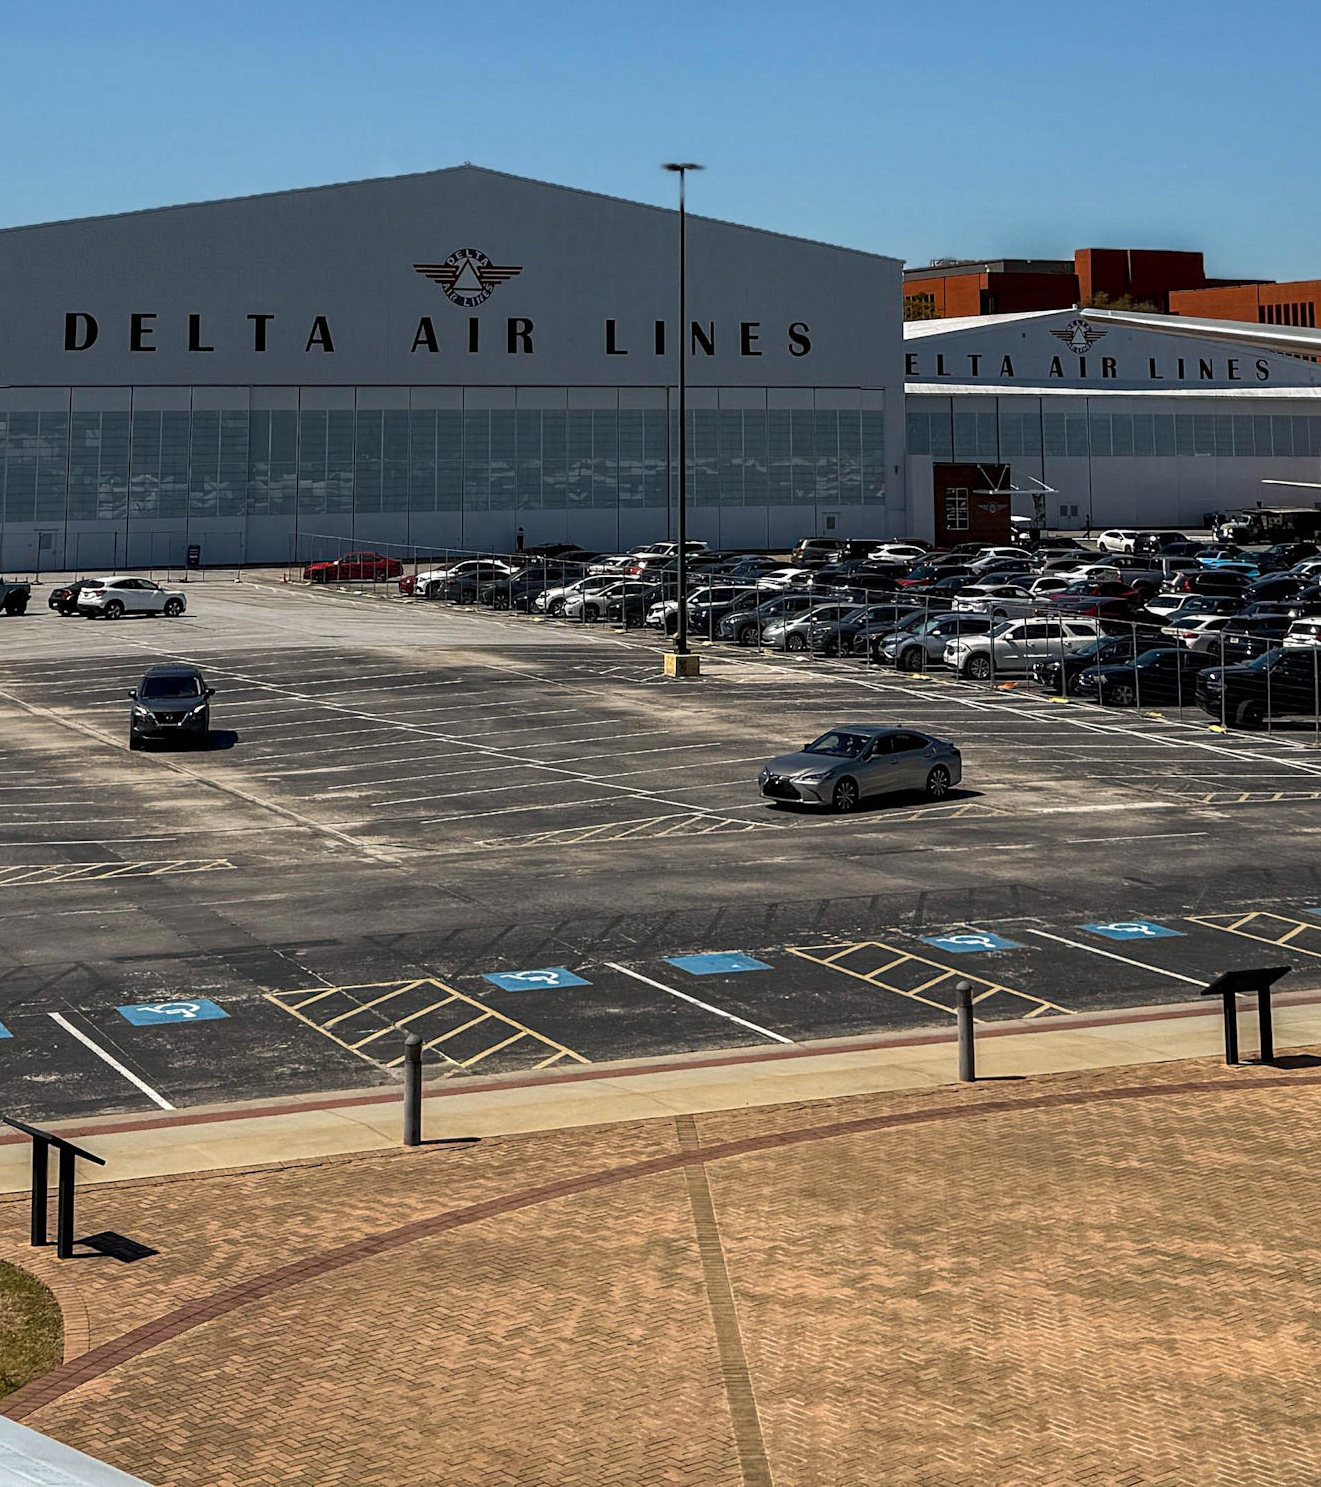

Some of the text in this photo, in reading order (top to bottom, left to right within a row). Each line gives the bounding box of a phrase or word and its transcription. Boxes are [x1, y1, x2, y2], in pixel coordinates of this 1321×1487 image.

[446, 249, 489, 267] DELTA
[442, 282, 493, 307] AIR LINES
[64, 312, 812, 357] DELTA AIR LINES
[905, 352, 1271, 381] ELTA AIR LINES
